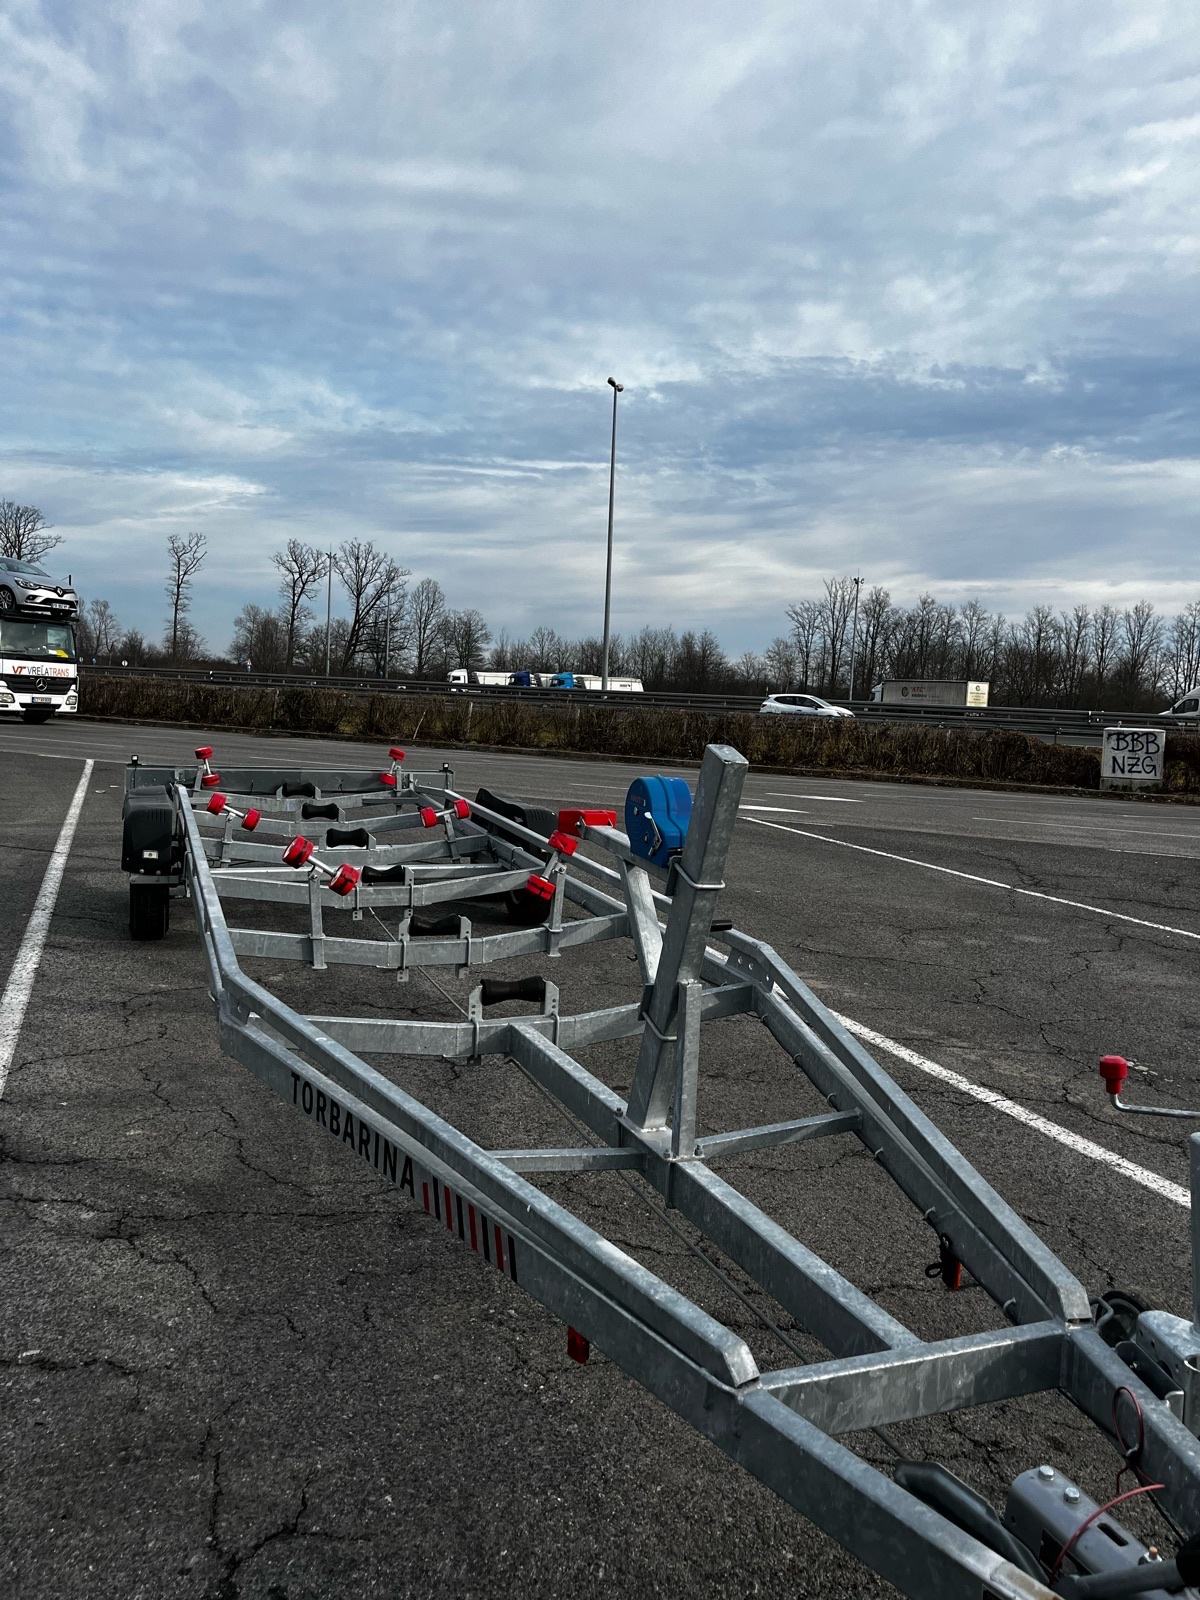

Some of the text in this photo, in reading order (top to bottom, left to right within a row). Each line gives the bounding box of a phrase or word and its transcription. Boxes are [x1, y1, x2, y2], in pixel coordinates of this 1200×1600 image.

[1107, 732, 1160, 754] BBB
[1112, 755, 1157, 776] NZG
[291, 1072, 415, 1199] TORBARINA
